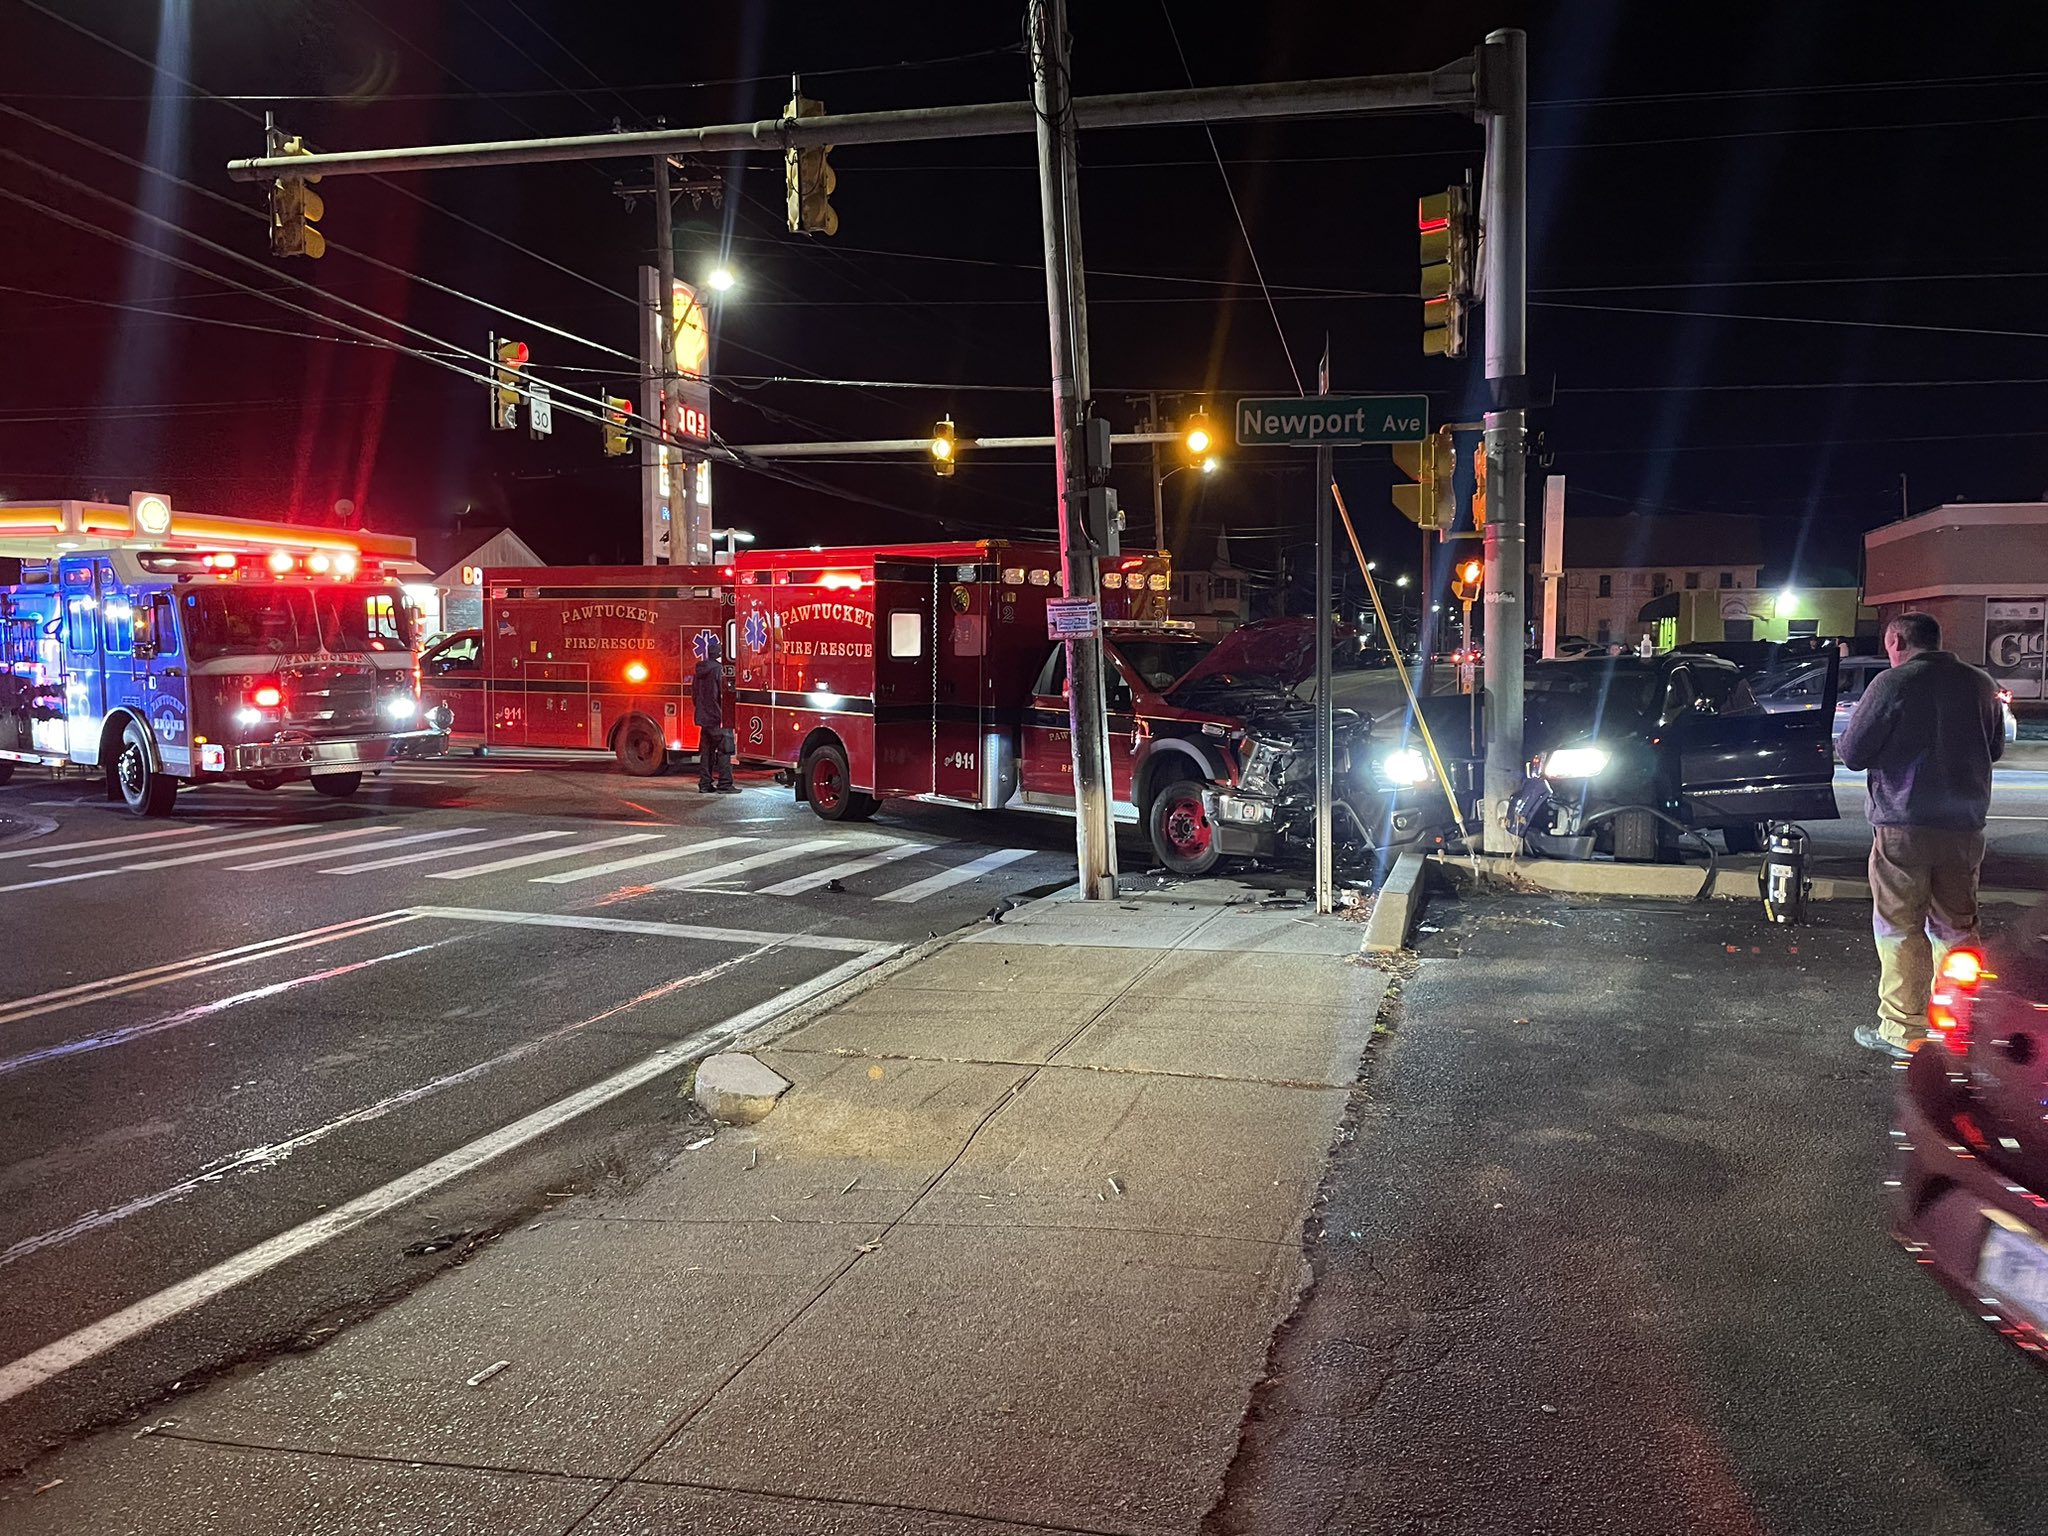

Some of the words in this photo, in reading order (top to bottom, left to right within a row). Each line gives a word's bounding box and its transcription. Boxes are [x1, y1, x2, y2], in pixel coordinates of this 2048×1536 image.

[534, 409, 549, 429] 30
[1243, 408, 1366, 439] Newport
[1382, 414, 1421, 433] Ave
[561, 604, 659, 625] PAWTUCKET
[780, 603, 875, 629] PAWTUCKET
[1002, 605, 1015, 624] 2
[564, 637, 656, 650] FIRE/RESCUE
[782, 640, 873, 658] FIRE/RESCUE
[285, 653, 363, 666] PAWTUCKET
[242, 675, 254, 689] 3
[395, 670, 405, 683] 3
[748, 715, 764, 745] 2
